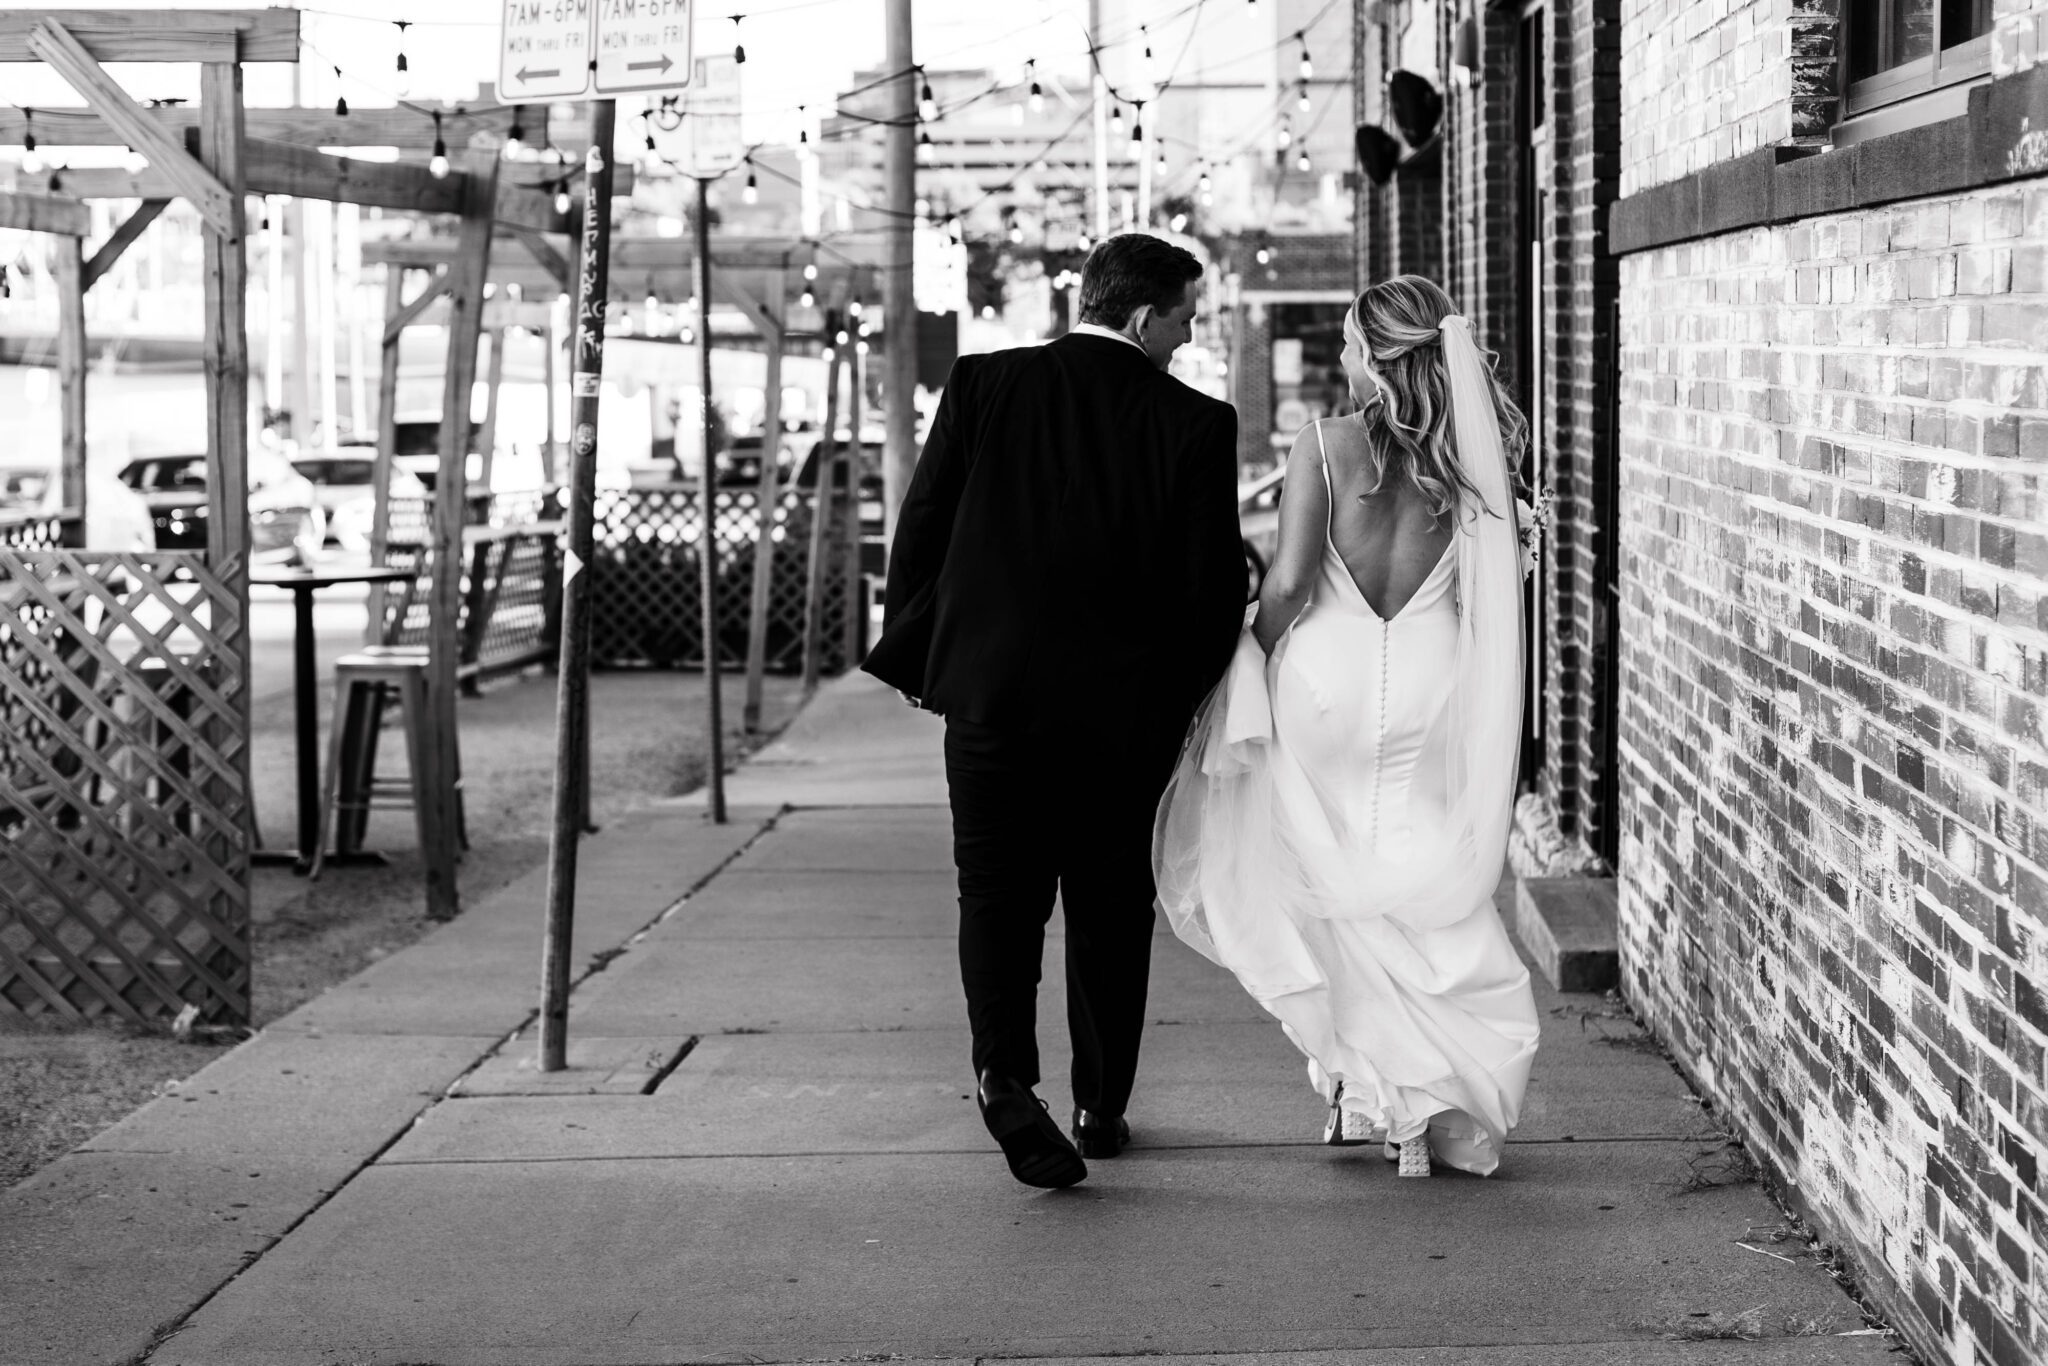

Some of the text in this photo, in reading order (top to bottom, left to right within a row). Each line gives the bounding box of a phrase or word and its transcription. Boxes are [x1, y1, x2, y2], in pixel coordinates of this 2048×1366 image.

[509, 0, 587, 27] 7AM-6PM
[508, 31, 585, 53] MON THRU FRI
[602, 25, 684, 49] MON THRU FRI
